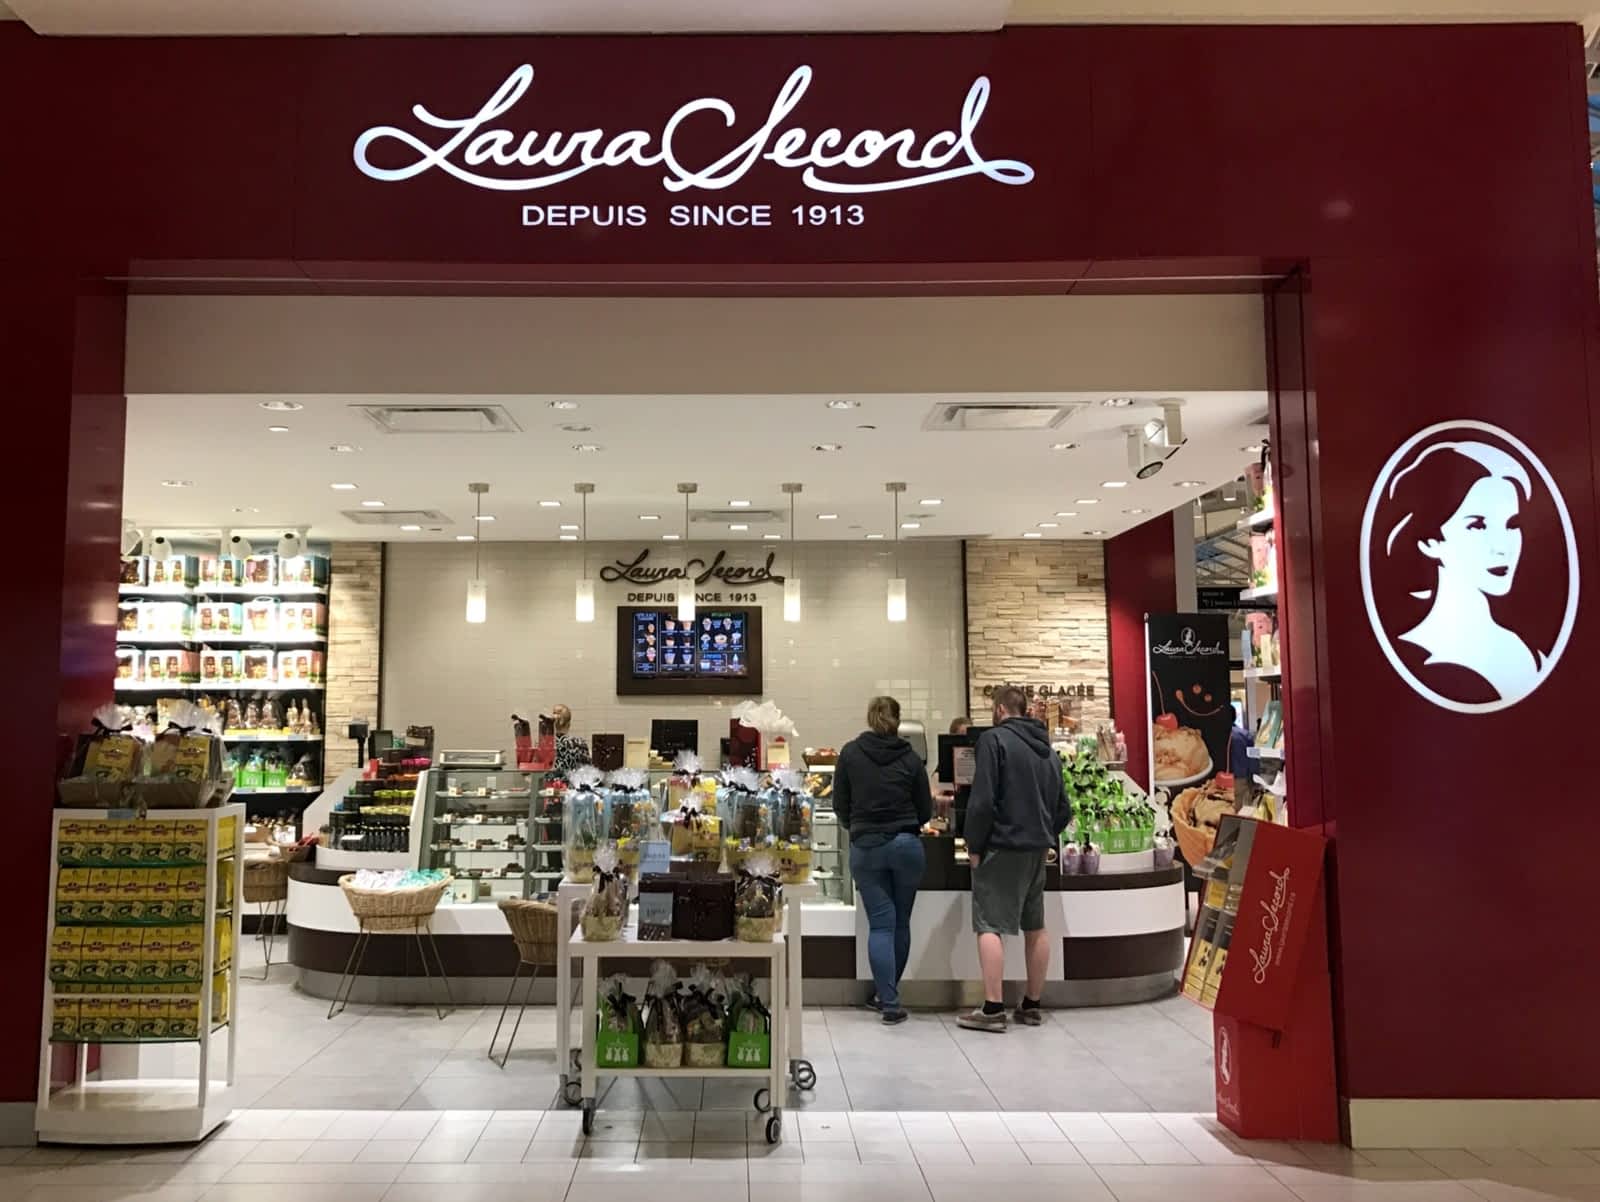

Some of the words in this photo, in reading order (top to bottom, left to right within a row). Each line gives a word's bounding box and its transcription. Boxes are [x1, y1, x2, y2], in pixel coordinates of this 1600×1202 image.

[353, 63, 664, 191] Laura
[660, 64, 1035, 194] Secord
[522, 205, 647, 227] DEPUIS
[669, 205, 772, 227] SINCE
[791, 205, 865, 226] 1913
[600, 548, 686, 586] Laura
[685, 549, 785, 586] Secord
[627, 592, 675, 603] DEPUIS
[729, 592, 757, 603] 1913
[1039, 682, 1095, 697] GLACÉE
[1249, 926, 1273, 984] Laura
